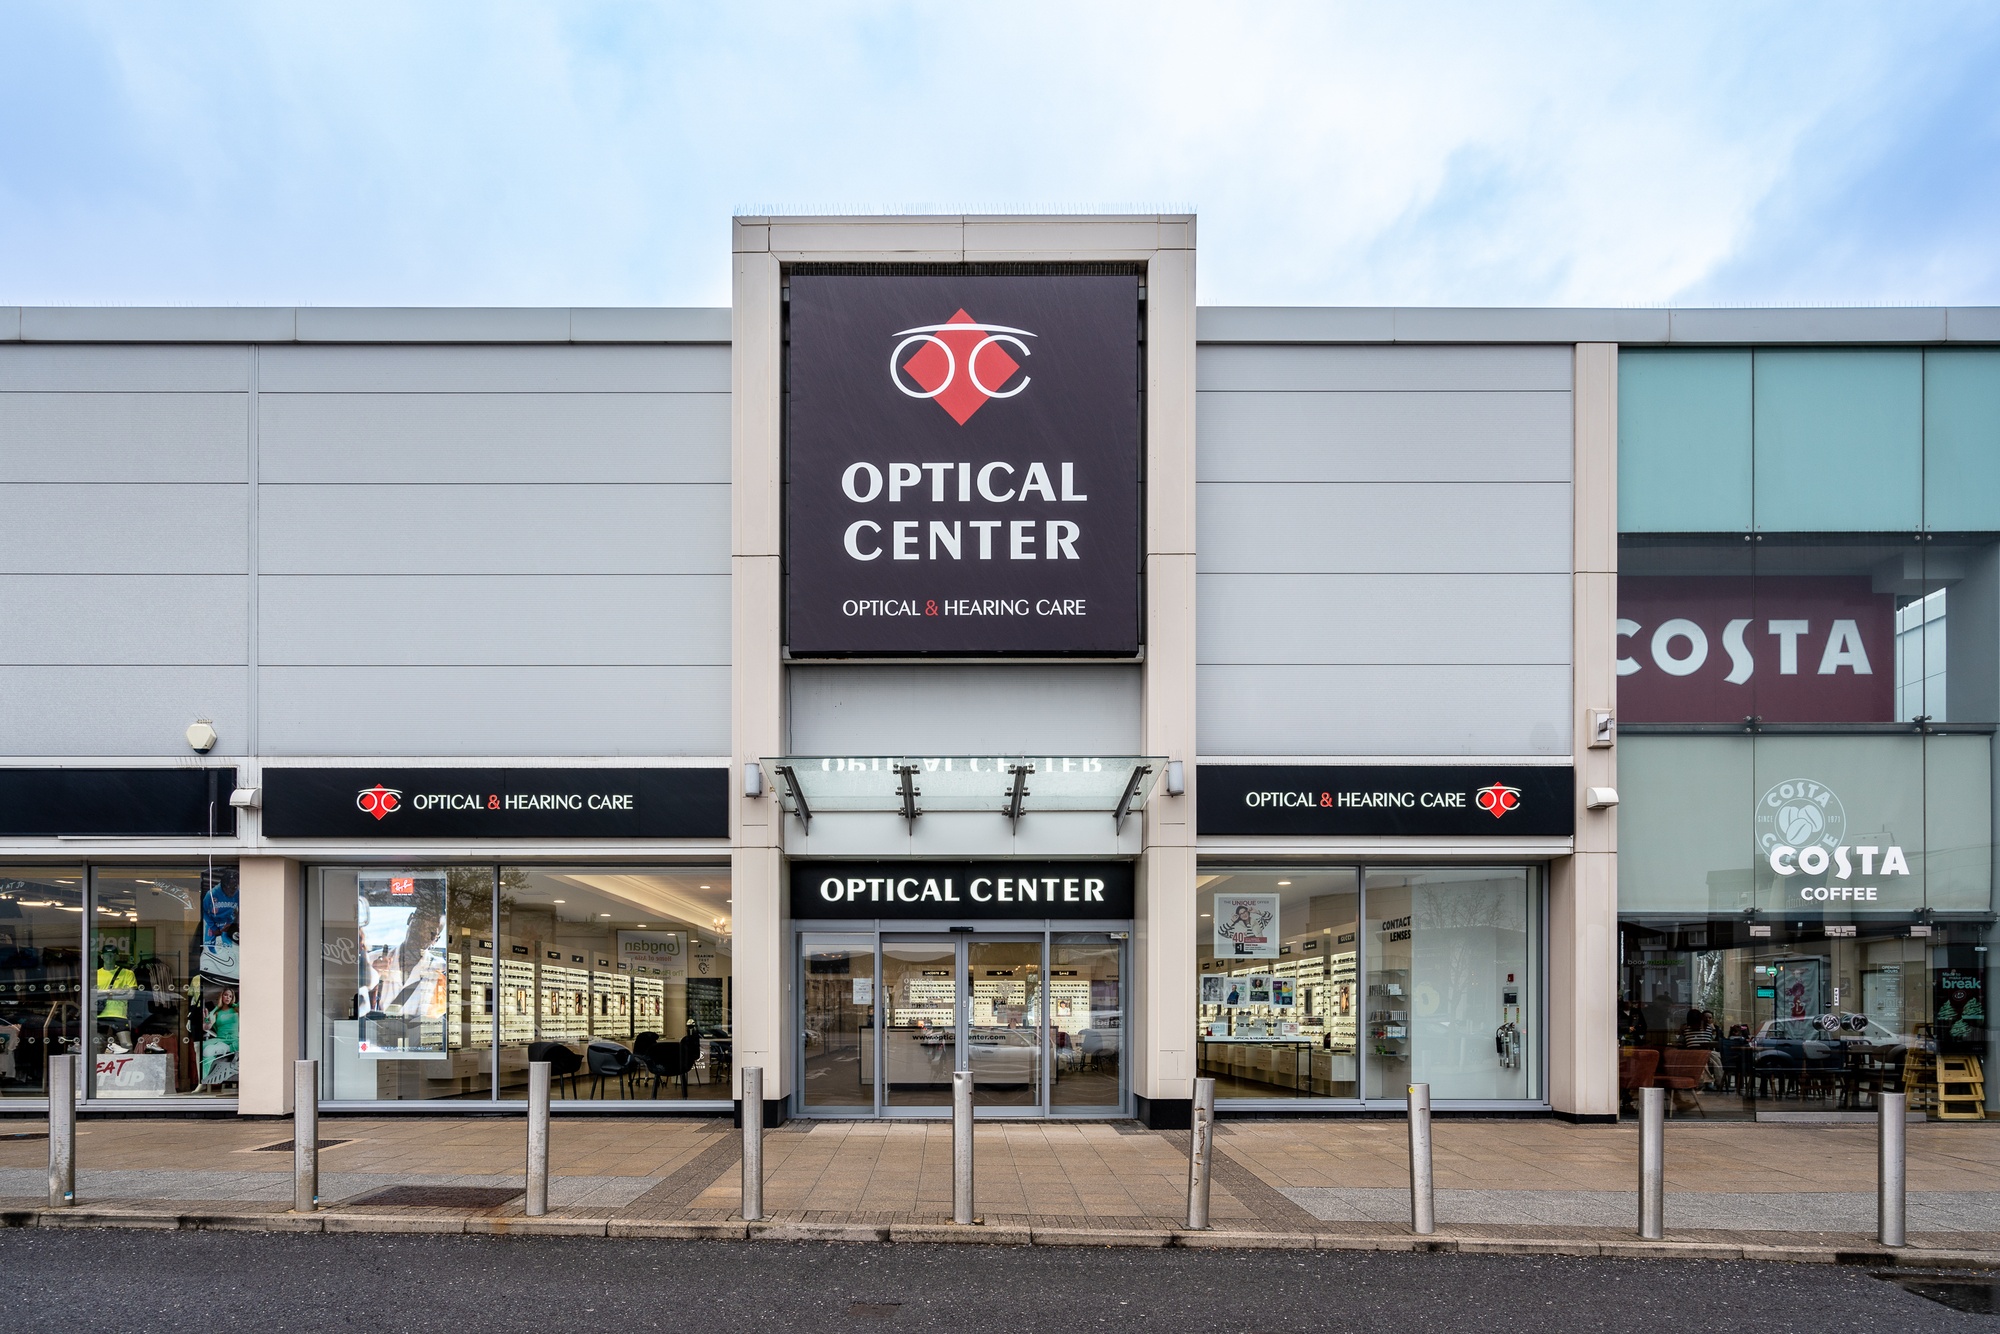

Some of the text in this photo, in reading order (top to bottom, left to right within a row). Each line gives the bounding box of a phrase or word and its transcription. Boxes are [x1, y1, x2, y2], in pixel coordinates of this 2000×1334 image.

[842, 462, 1087, 502] OPTICAL
[844, 520, 1080, 561] CENTER
[843, 600, 1086, 616] OPTICAL & HEARING CARE
[414, 794, 485, 810] OPTICAL
[488, 794, 500, 810] &
[505, 794, 582, 810] HEARING
[588, 794, 633, 810] CARE
[1246, 792, 1317, 808] OPTICAL
[1320, 792, 1333, 808] &
[1338, 792, 1414, 808] HEARING
[1420, 792, 1466, 808] CARE
[1767, 782, 1831, 808] COSTA
[1770, 846, 1910, 880] COSTA
[820, 877, 1104, 901] OPTICAL CENTER
[1801, 887, 1877, 900] COFFEE
[1382, 916, 1411, 931] CONTACT
[1390, 929, 1411, 942] LENSES
[1942, 978, 1981, 989] break
[97, 1058, 133, 1076] EAT
[115, 1071, 145, 1086] UP
